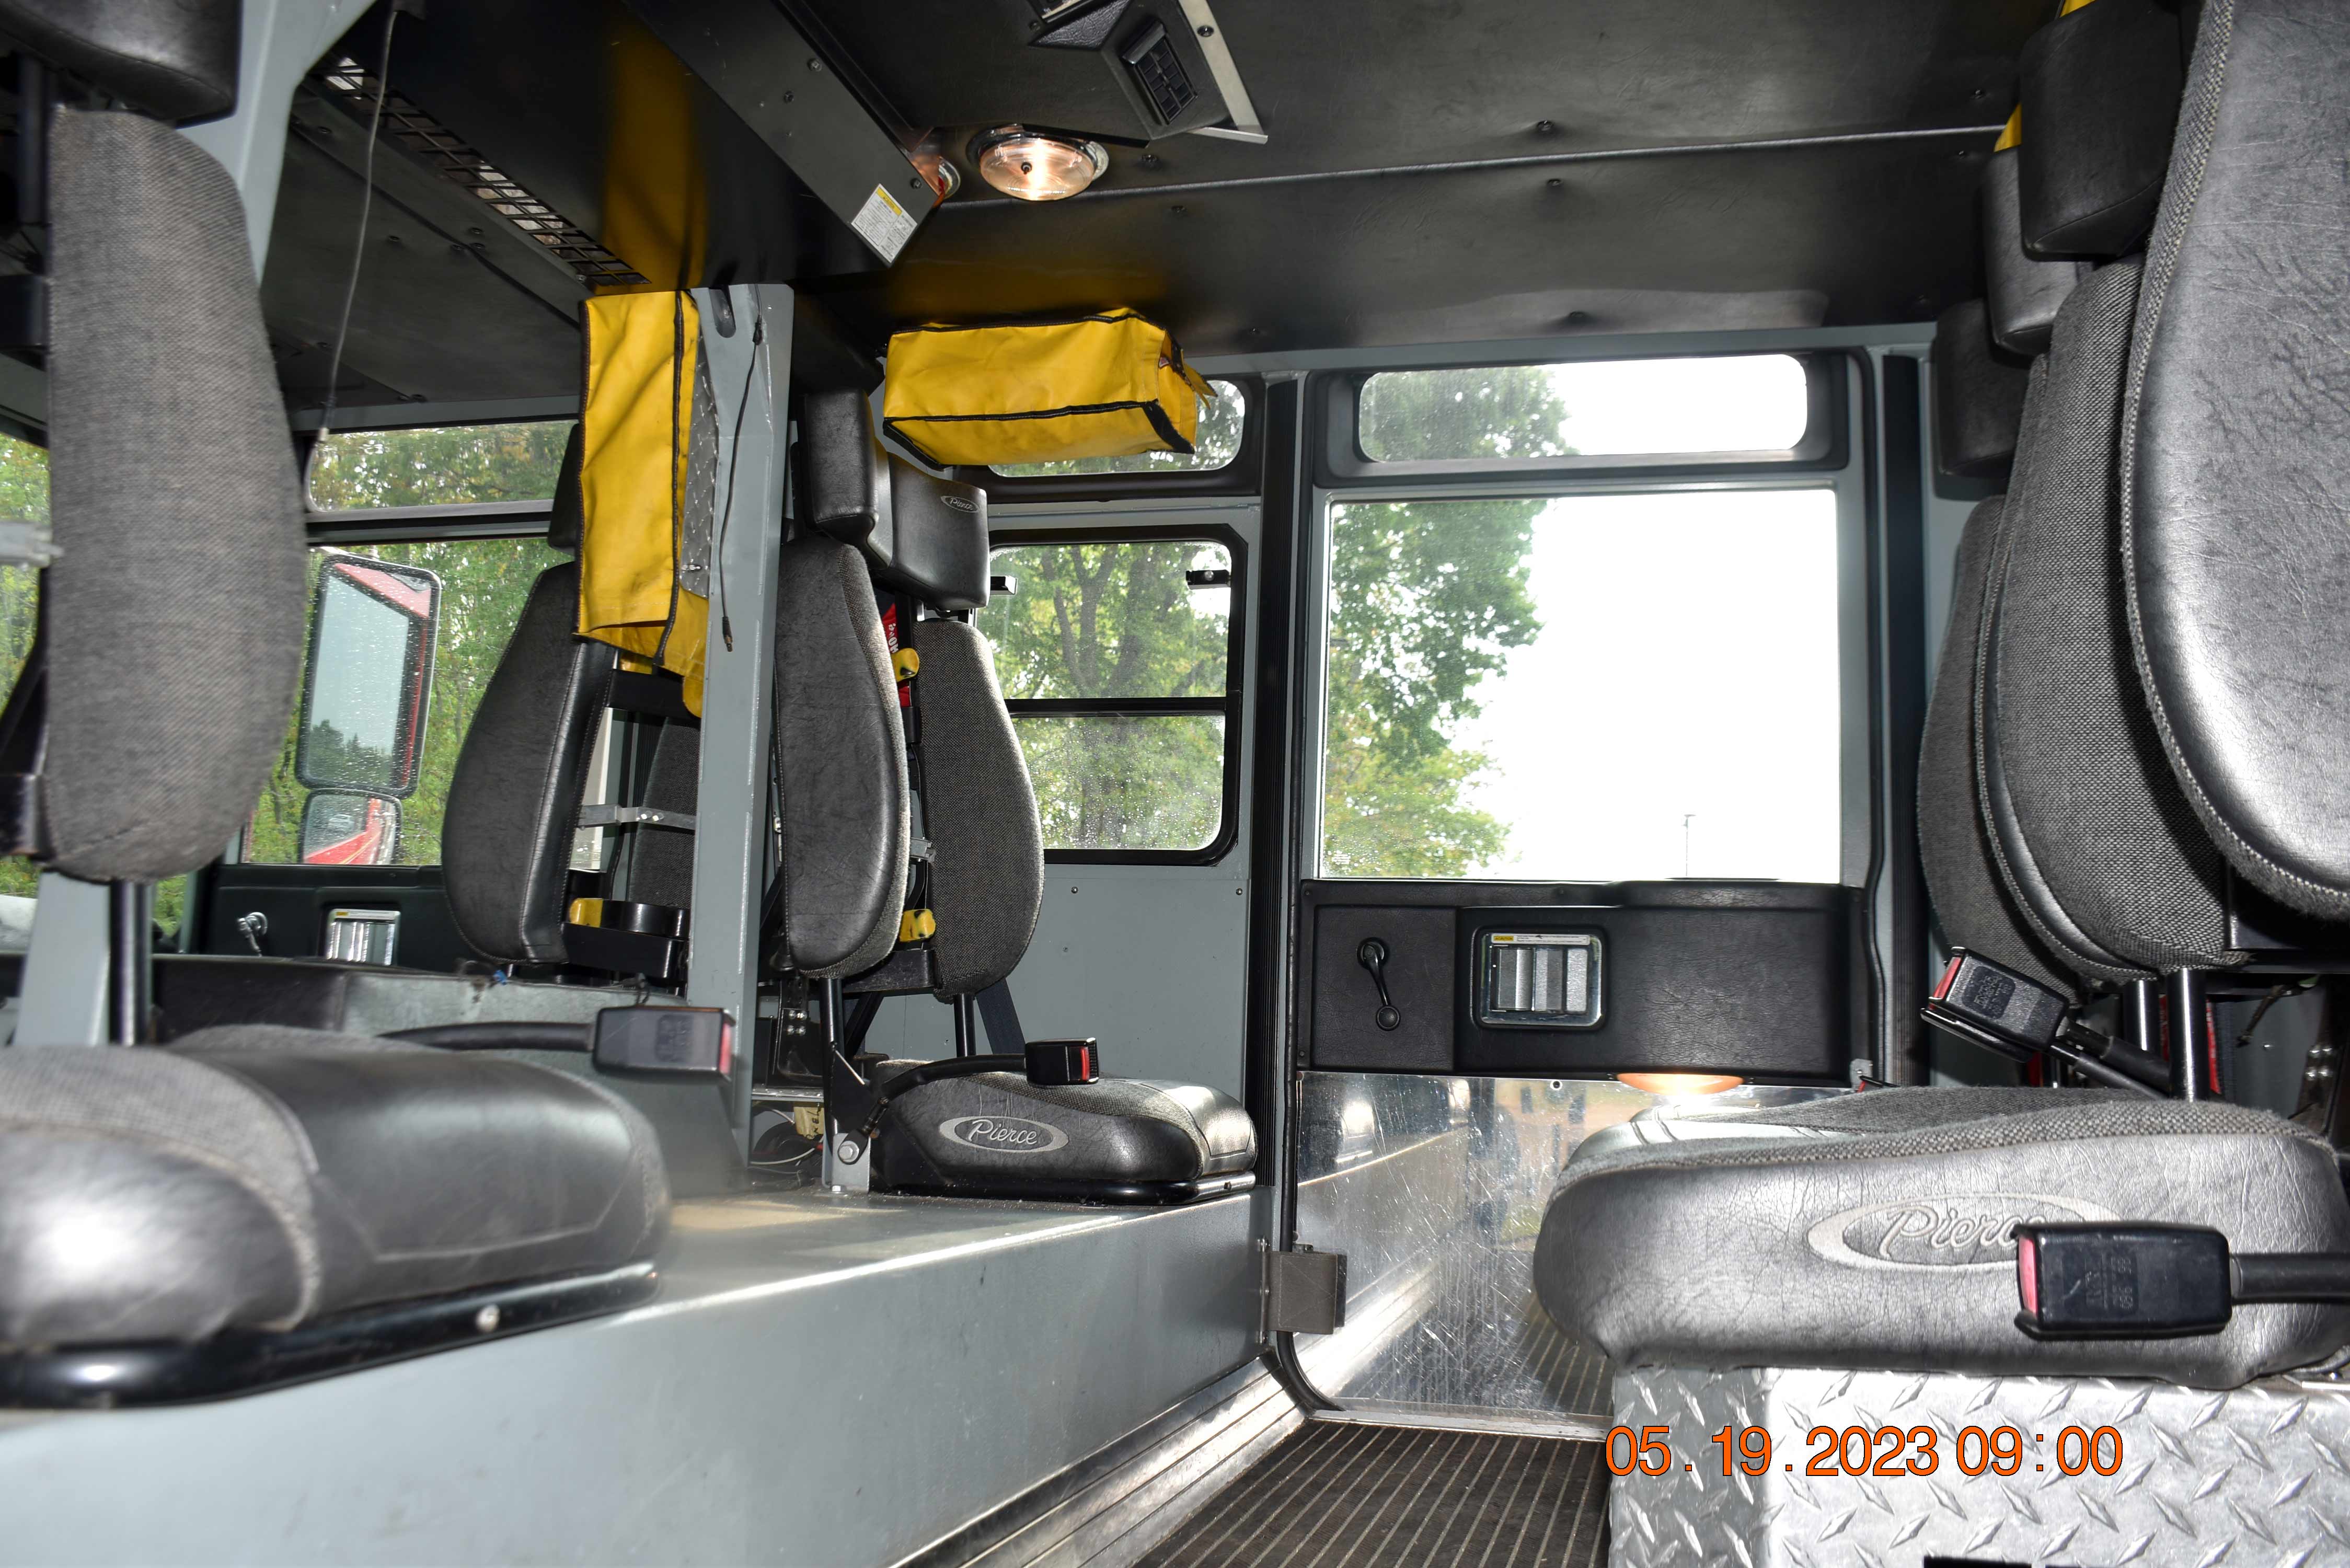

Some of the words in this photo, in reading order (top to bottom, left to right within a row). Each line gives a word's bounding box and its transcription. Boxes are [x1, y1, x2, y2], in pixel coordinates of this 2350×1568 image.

[950, 497, 973, 510] Pierce
[967, 1119, 1038, 1145] Pierce
[1878, 1204, 2045, 1255] Pierc
